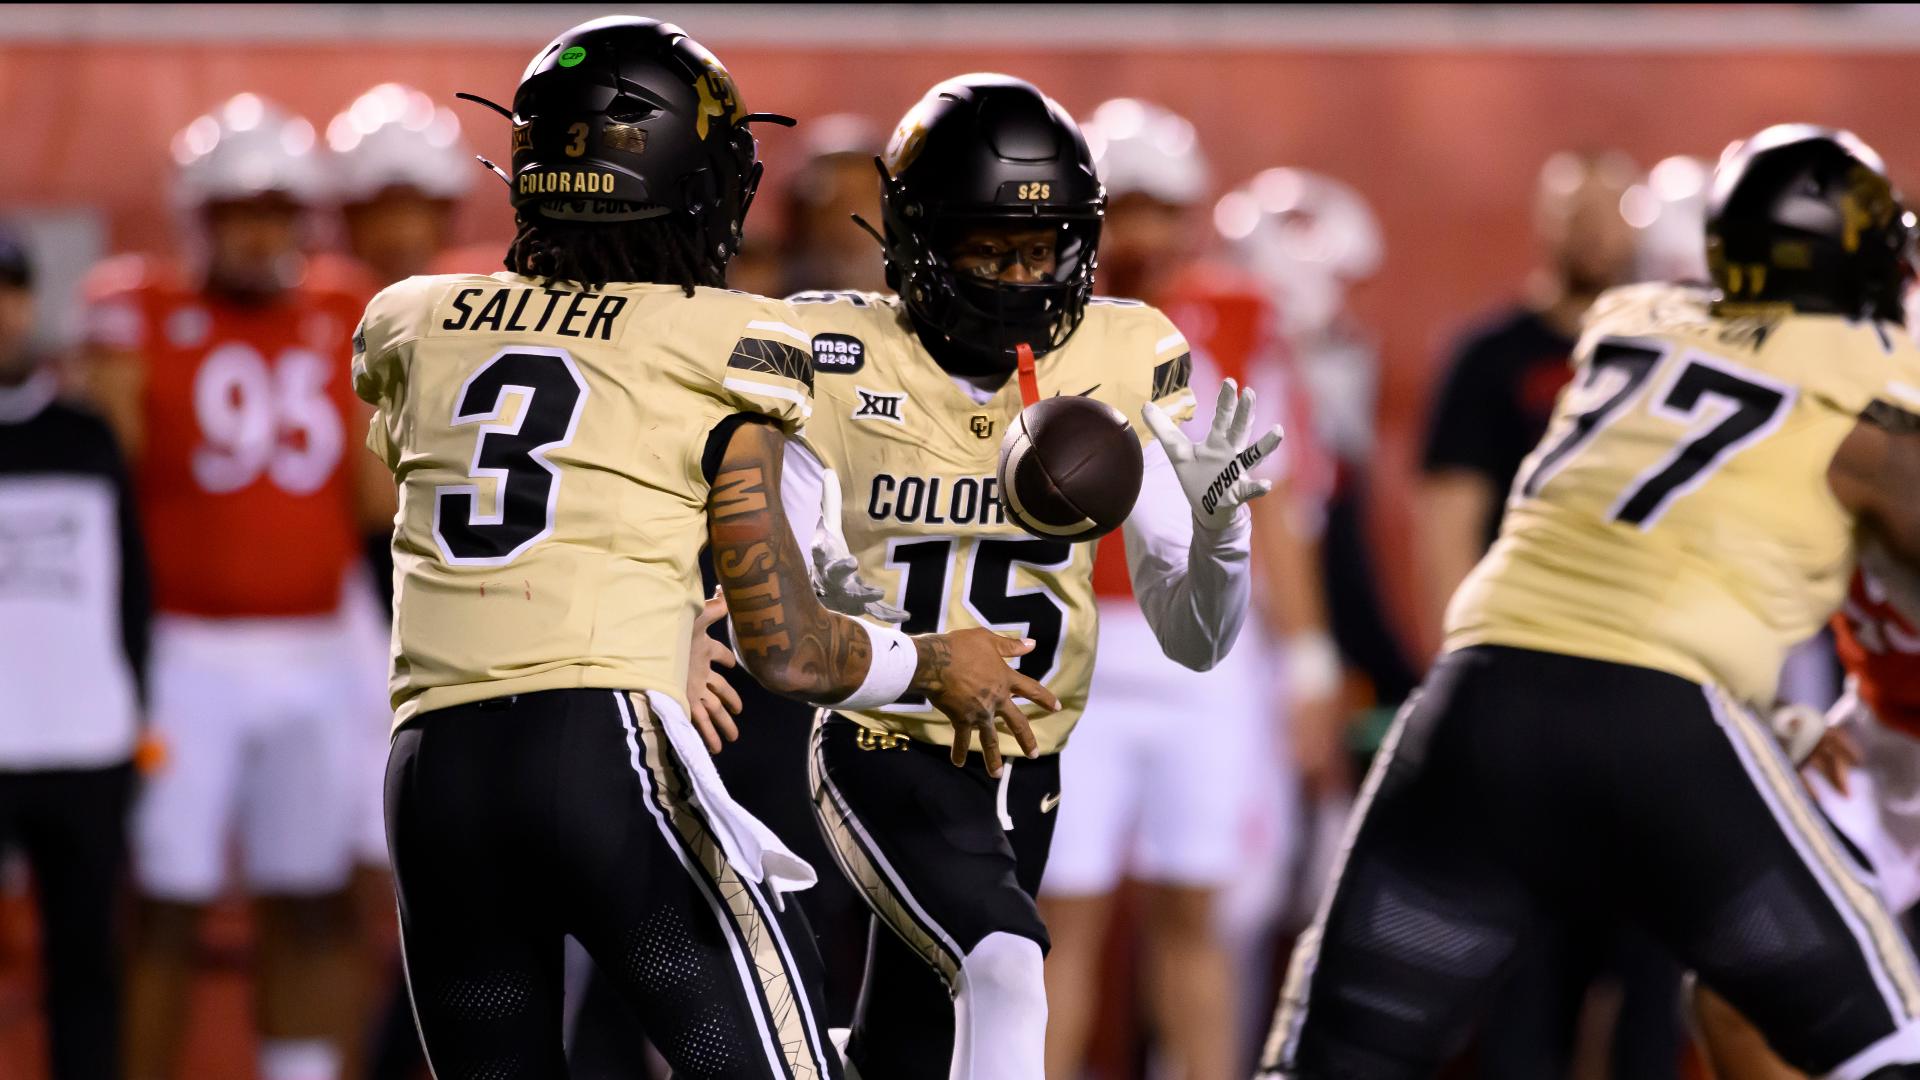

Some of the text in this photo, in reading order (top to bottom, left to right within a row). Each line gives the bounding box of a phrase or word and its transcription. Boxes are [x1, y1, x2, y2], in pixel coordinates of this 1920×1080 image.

[561, 52, 584, 61] C2P
[564, 121, 590, 157] 3
[519, 171, 615, 194] COLORADO
[442, 287, 629, 341] SALTER
[814, 339, 861, 355] mac
[818, 353, 856, 366] 82-94
[188, 340, 348, 496] 95
[856, 390, 904, 421] XII
[970, 415, 995, 440] CU
[432, 345, 591, 567] 3
[1520, 335, 1798, 534] 77
[867, 473, 1006, 526] COLOR
[1201, 442, 1262, 516] COLORADO
[884, 534, 1074, 713] 15
